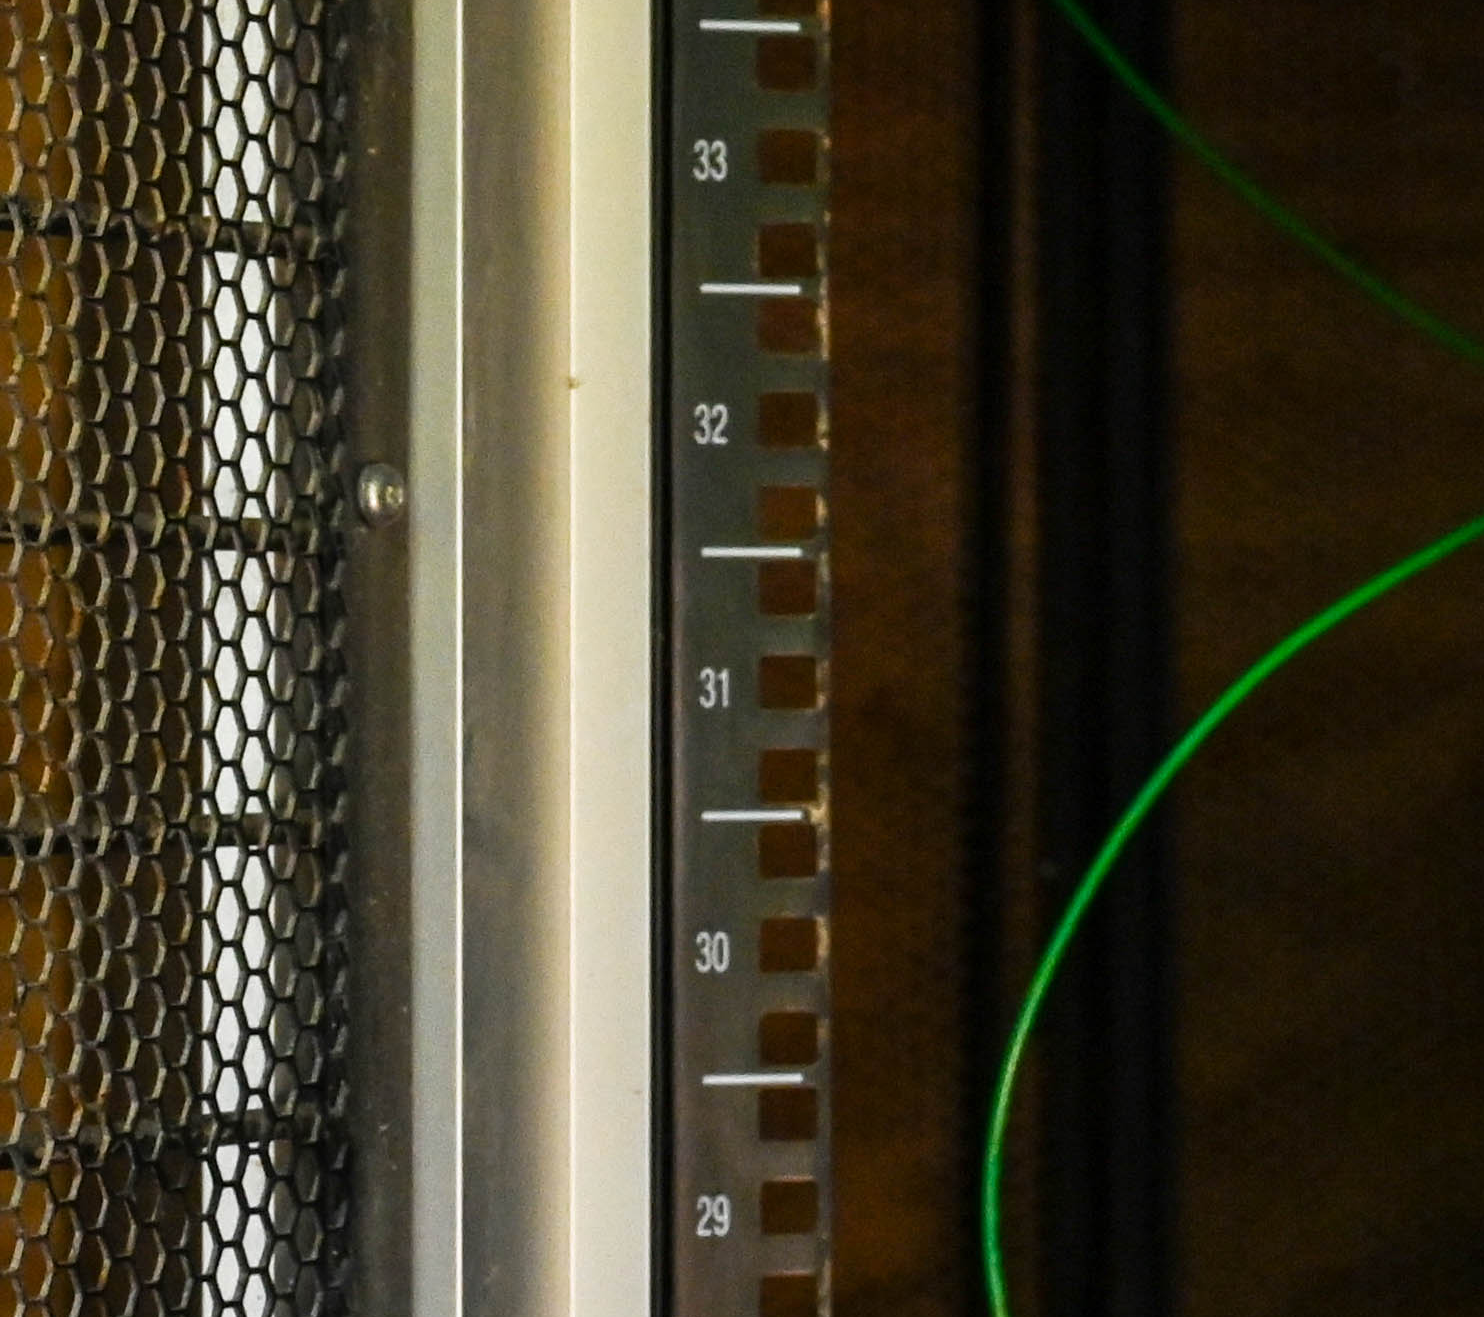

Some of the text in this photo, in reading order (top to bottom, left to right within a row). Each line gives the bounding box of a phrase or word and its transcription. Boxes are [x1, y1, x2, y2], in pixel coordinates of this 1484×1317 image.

[693, 139, 728, 182] 33
[694, 403, 729, 445] 32
[699, 667, 730, 708] 31
[696, 931, 730, 973] 30
[696, 1194, 731, 1237] 29
